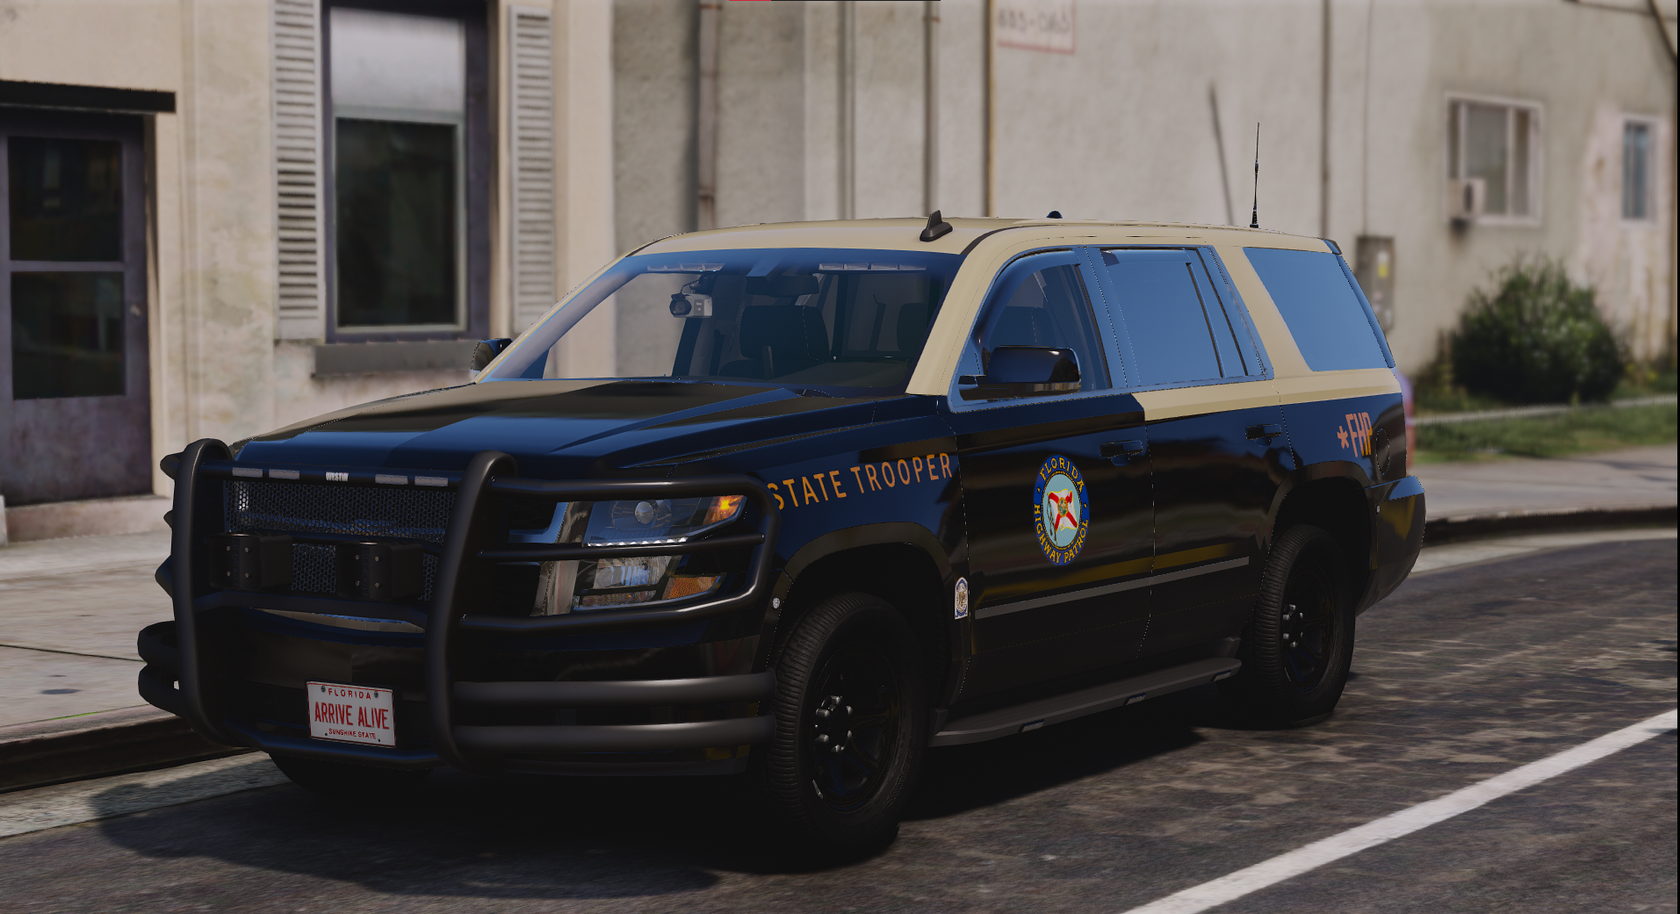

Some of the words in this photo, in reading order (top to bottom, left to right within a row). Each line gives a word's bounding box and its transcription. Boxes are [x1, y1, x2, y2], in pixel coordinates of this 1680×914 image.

[767, 470, 847, 510] STATE
[850, 453, 952, 494] TROOPER
[1040, 457, 1085, 493] FLORIDA
[1034, 504, 1062, 563] HIGHWAY
[1064, 519, 1089, 564] PATROL
[328, 688, 371, 700] FLORIDA
[315, 701, 354, 726] ARRIVE
[358, 706, 390, 730] ALIVE
[357, 731, 377, 740] STATE
